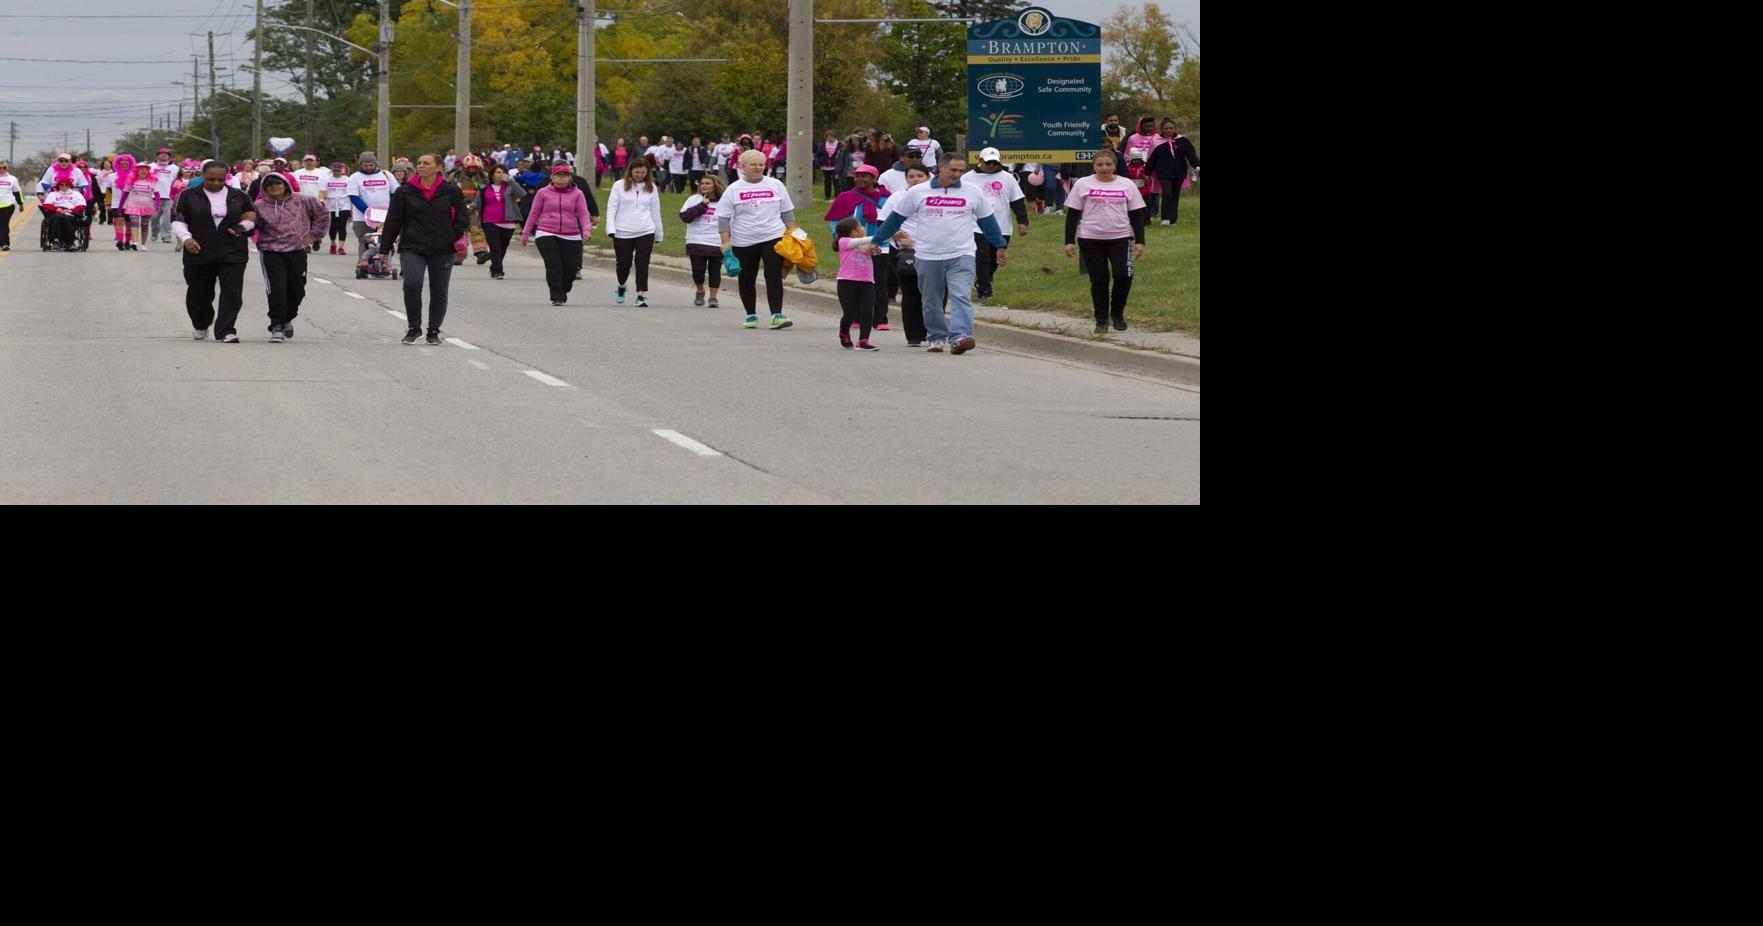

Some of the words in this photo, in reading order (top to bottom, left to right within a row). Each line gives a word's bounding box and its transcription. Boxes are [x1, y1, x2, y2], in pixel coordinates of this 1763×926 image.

[989, 40, 1080, 54] BRAMPTON
[1054, 86, 1092, 94] Community
[1064, 121, 1090, 129] Friendly
